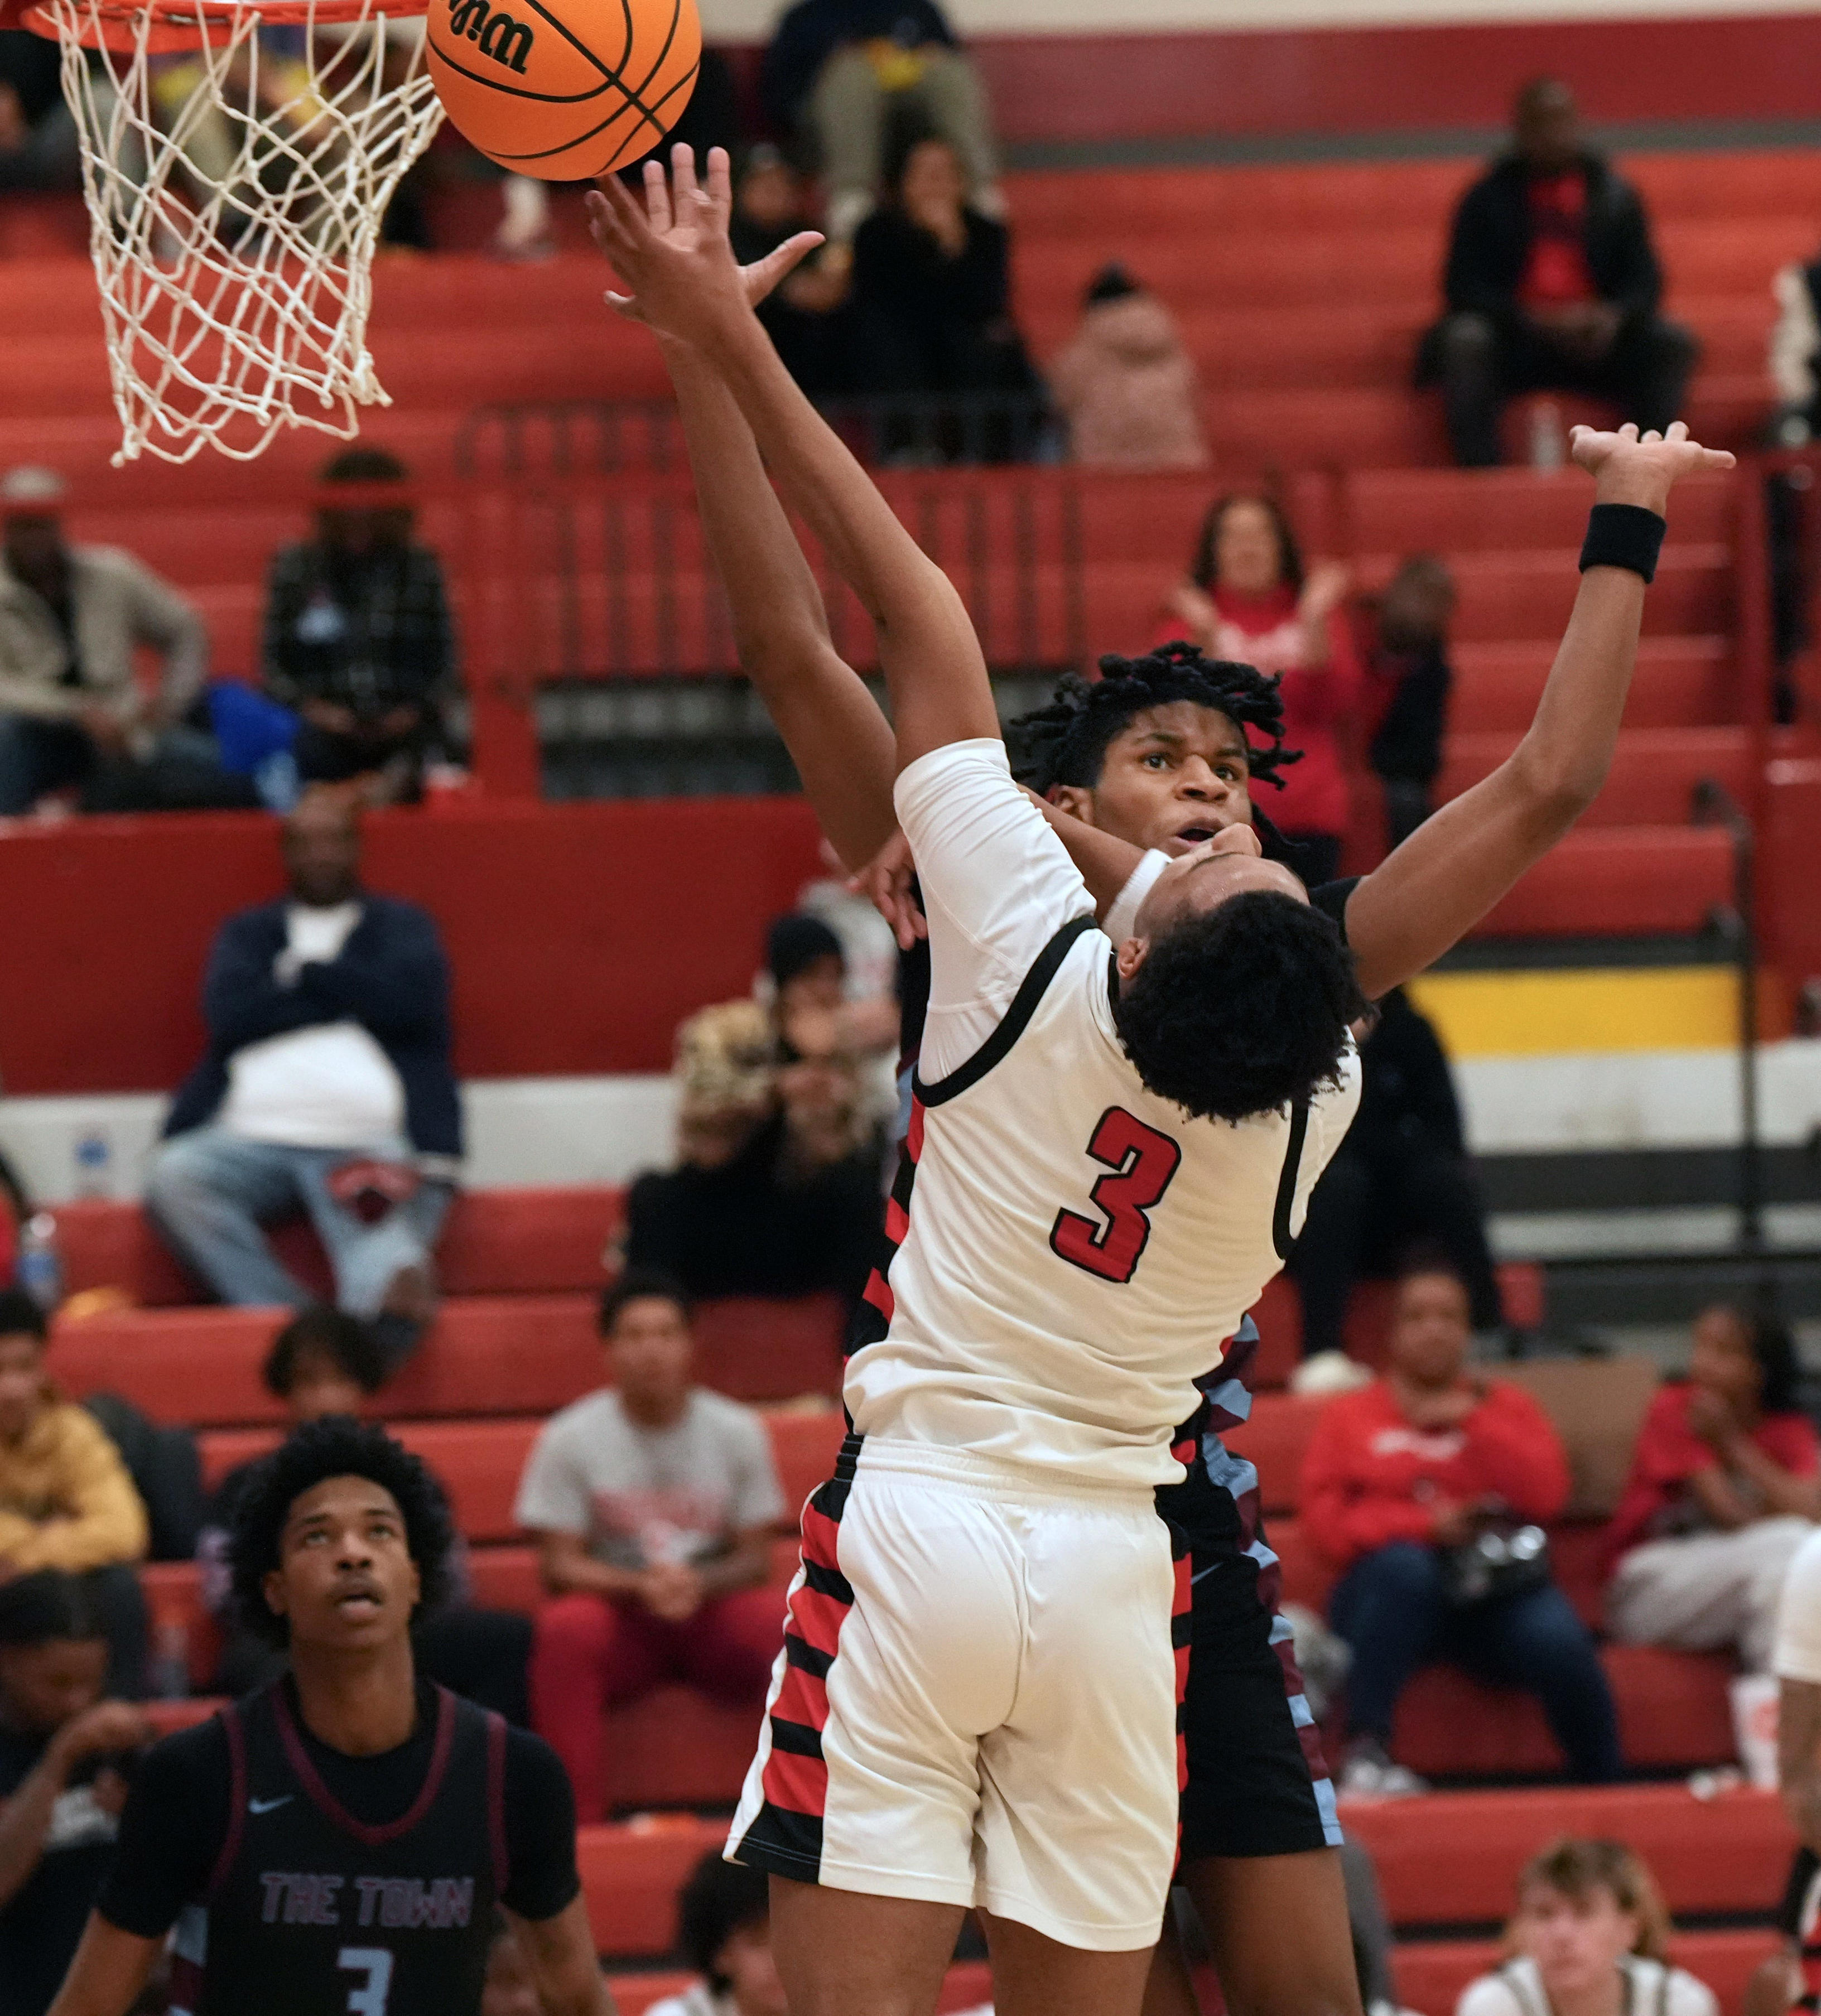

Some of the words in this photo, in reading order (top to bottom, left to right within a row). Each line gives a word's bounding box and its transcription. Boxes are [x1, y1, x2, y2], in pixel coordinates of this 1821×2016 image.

[448, 0, 534, 75] Wil
[1049, 1105, 1182, 1284] 3
[259, 1871, 344, 1925] THE
[354, 1875, 475, 1928] TOWN
[336, 1946, 396, 2016] 3
